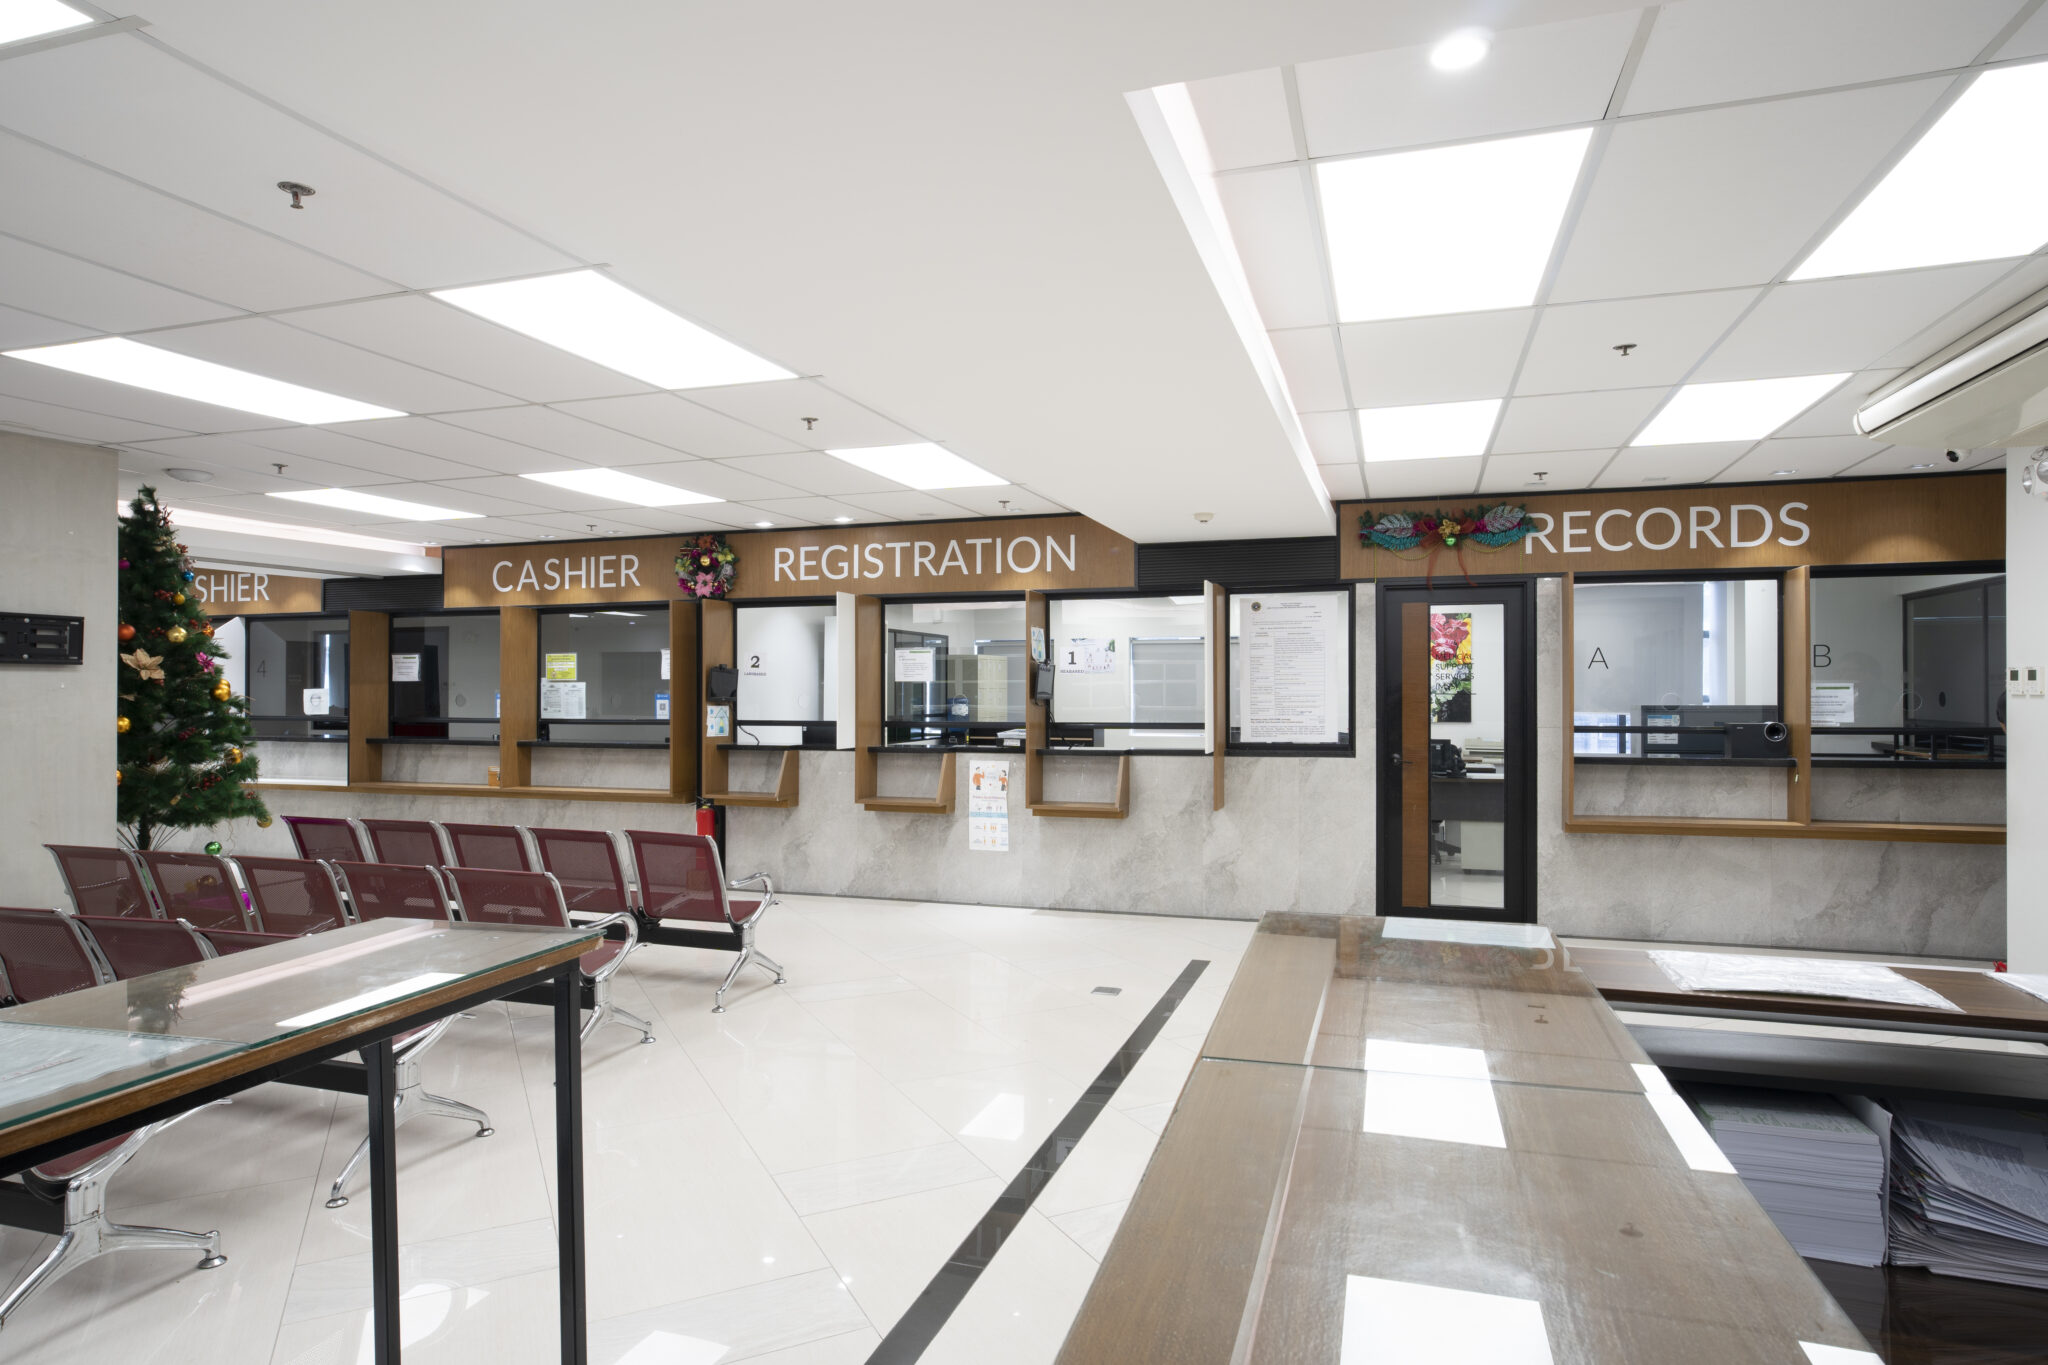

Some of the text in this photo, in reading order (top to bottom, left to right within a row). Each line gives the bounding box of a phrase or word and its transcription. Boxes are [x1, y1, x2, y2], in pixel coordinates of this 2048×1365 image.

[1525, 502, 1811, 554] RECORDS
[774, 534, 1076, 582] REGISTRATION
[492, 554, 641, 593] CASHIER
[194, 573, 270, 603] SHIER
[750, 655, 760, 669] 2
[1068, 651, 1077, 665] 1
[1435, 663, 1475, 671] SUPPORT
[1588, 647, 1609, 669] A
[1813, 644, 1832, 668] B
[256, 660, 267, 678] 4
